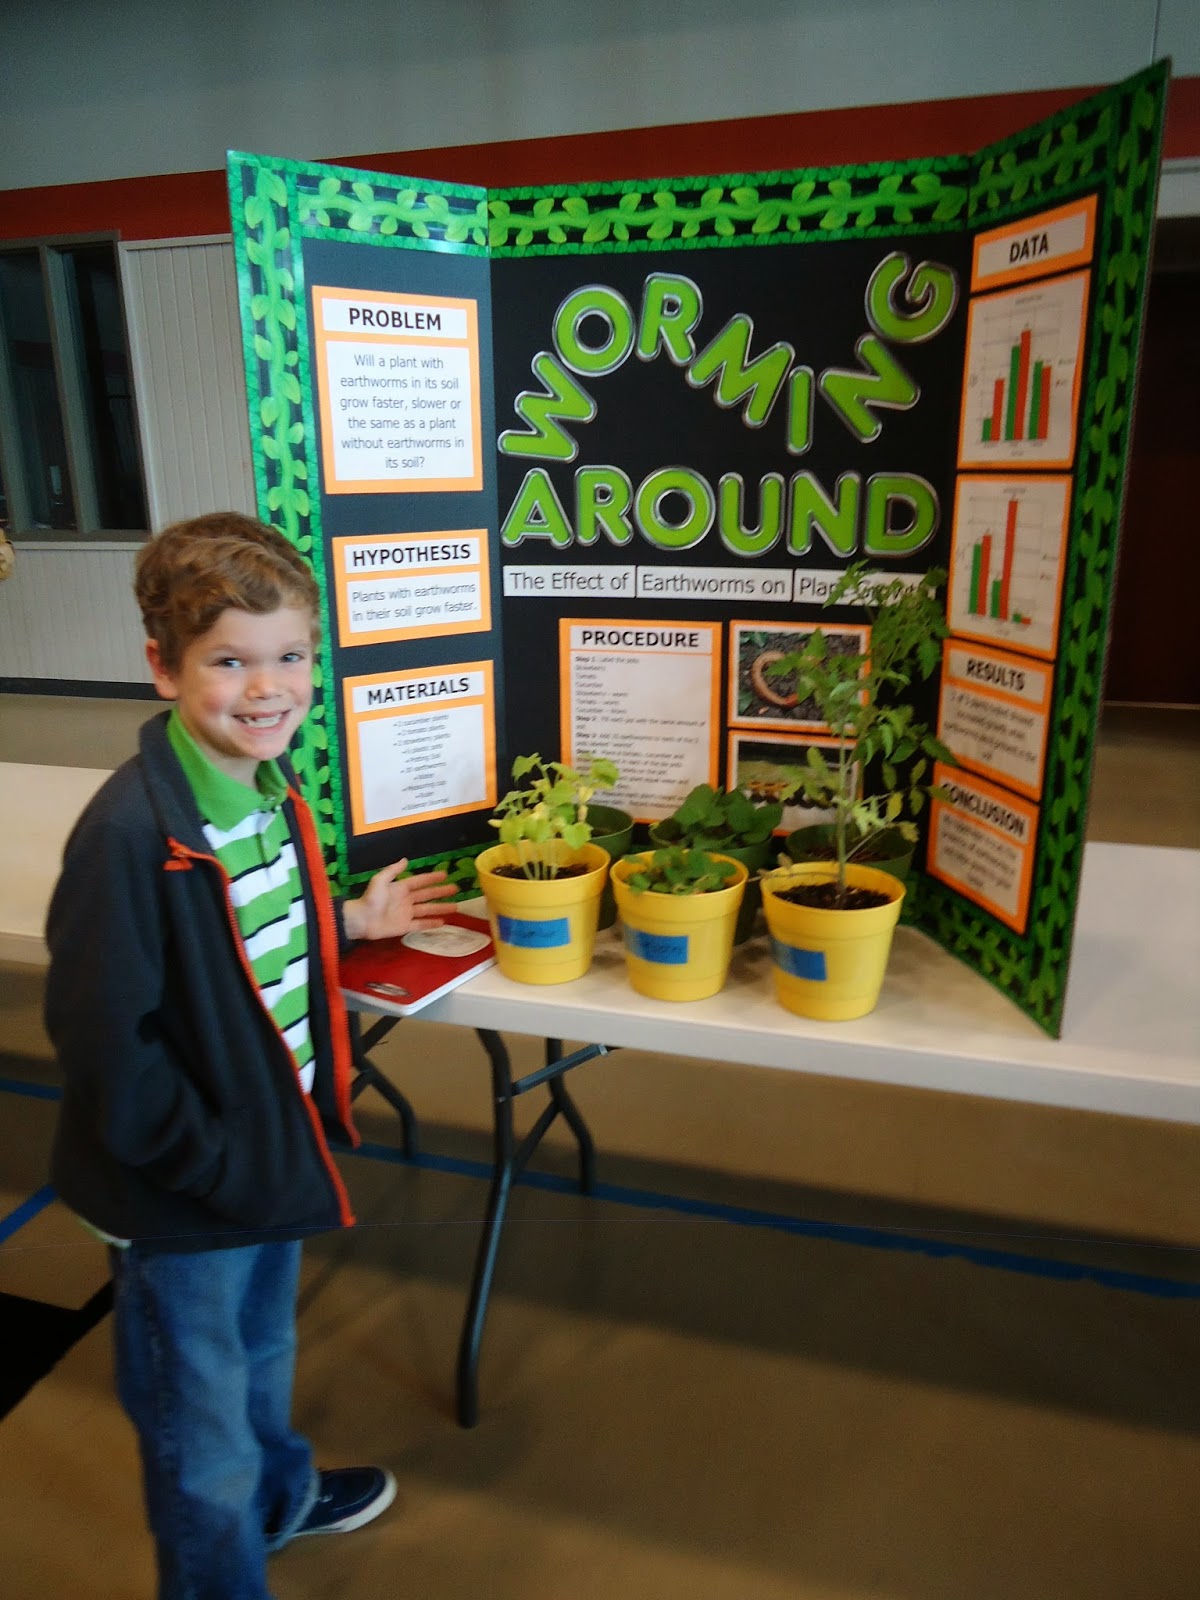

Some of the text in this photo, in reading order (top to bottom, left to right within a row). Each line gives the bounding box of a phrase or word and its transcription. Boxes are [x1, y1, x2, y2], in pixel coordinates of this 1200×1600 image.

[1009, 232, 1049, 263] DATA
[349, 308, 441, 330] PROBLEM
[354, 354, 444, 370] Will a plant with
[498, 251, 958, 463] WORMING
[340, 376, 459, 390] earthworms in its soil
[340, 396, 461, 411] grow faster, slower or
[348, 417, 456, 431] the same as a plant
[341, 437, 464, 449] without earthworms in
[385, 456, 425, 469] its soil?
[500, 465, 940, 558] AROUND
[353, 544, 471, 567] HYPOTHESIS
[352, 582, 476, 602] Plants with earthworms
[509, 572, 545, 590] The
[552, 572, 604, 590] Effect
[610, 572, 630, 590] of
[642, 573, 754, 594] Earthworms
[762, 580, 785, 594] on
[800, 577, 847, 597] Pla
[353, 601, 477, 621] in their soil grow faster.
[582, 630, 700, 647] PROCEDURE
[966, 658, 1026, 692] RESULTS
[368, 677, 469, 705] MATERIALS
